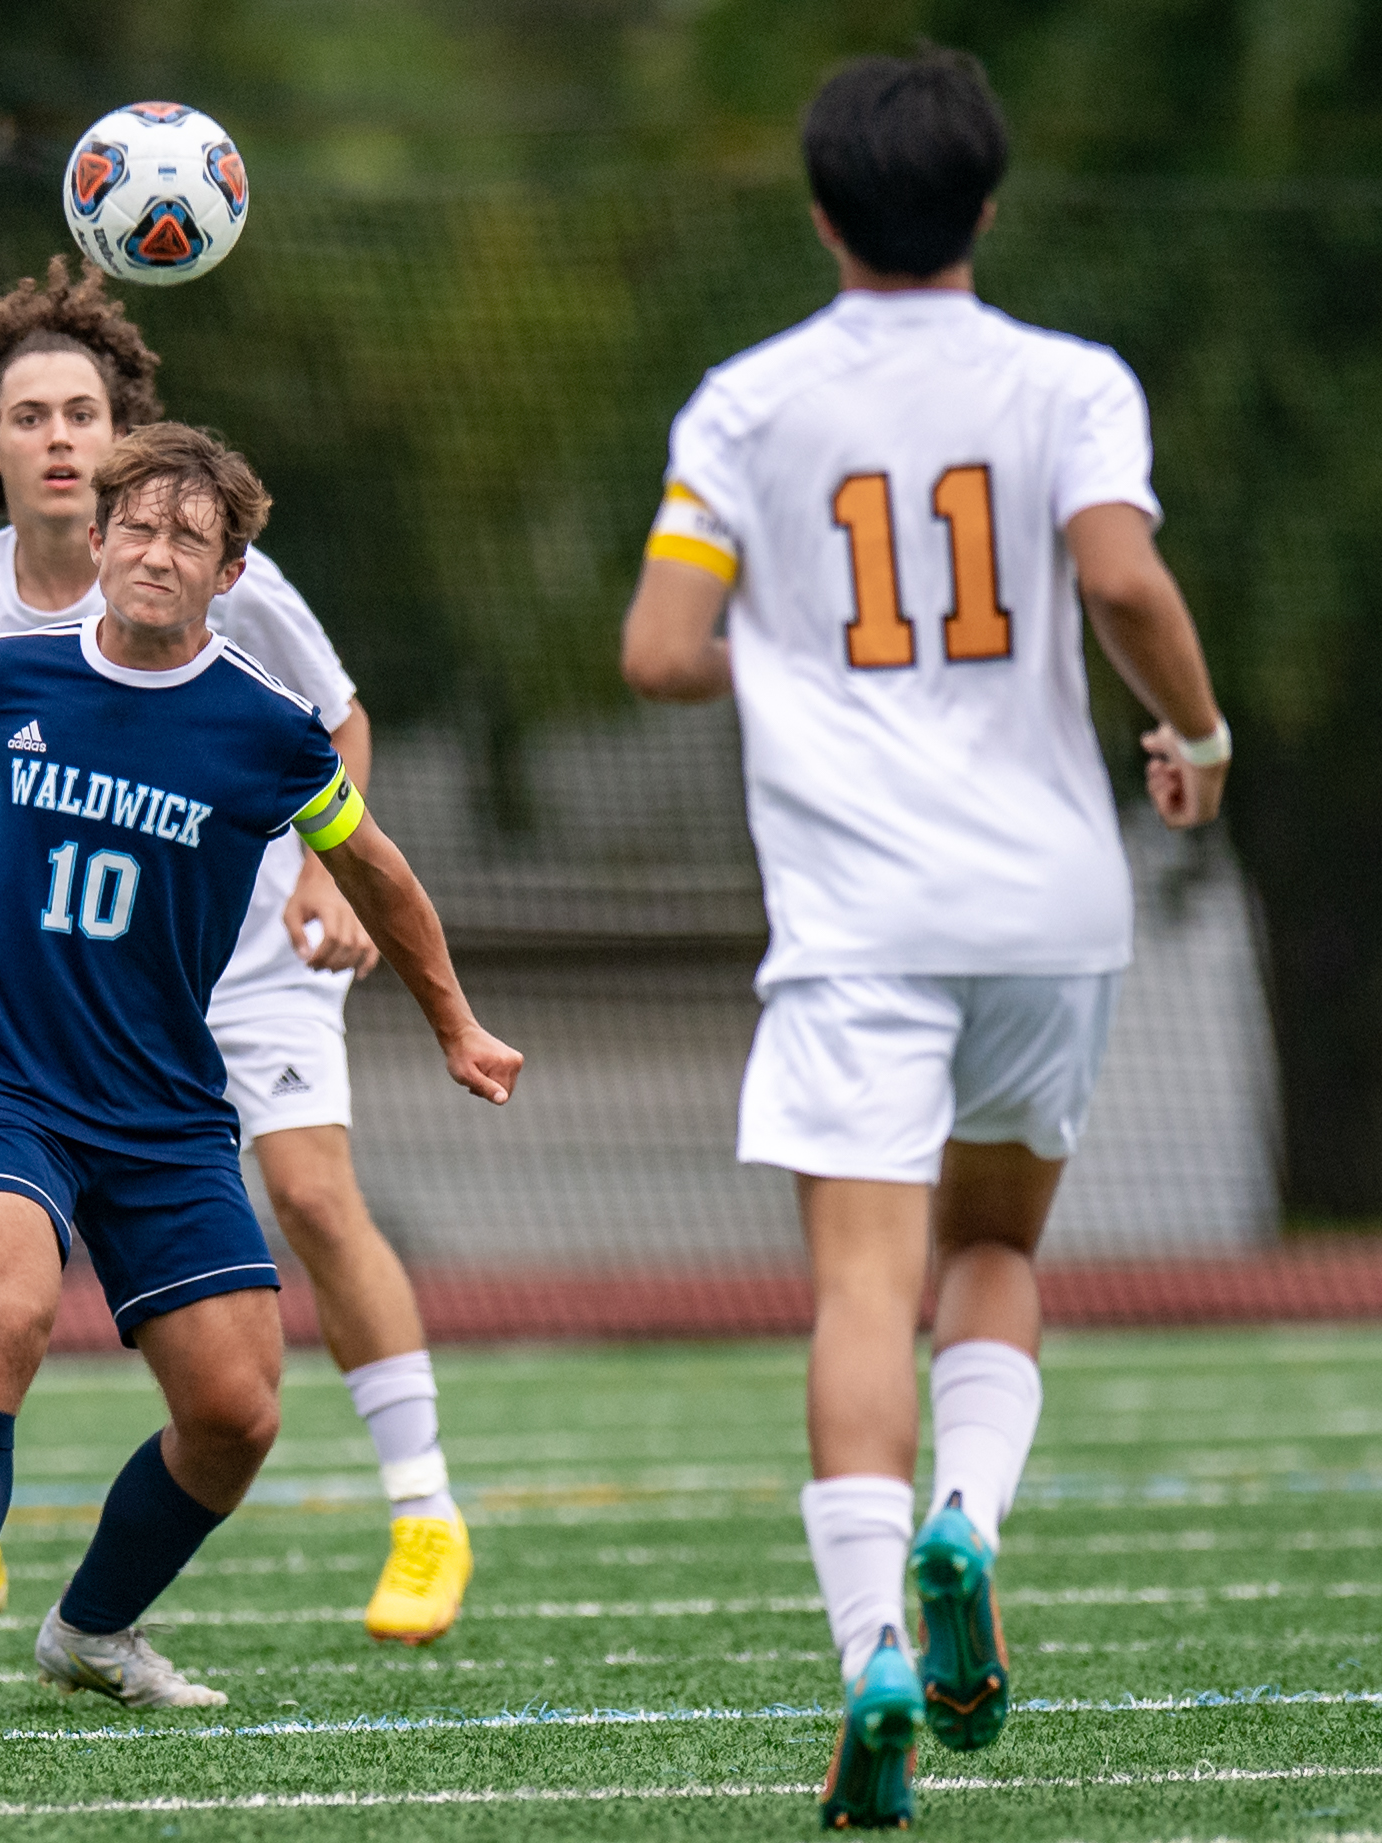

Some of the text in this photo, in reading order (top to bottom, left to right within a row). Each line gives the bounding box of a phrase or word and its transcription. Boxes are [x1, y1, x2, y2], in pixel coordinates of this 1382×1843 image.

[831, 463, 1014, 671] 11
[7, 738, 47, 753] adidas
[11, 758, 213, 848] WALDWICK
[41, 840, 141, 941] 10
